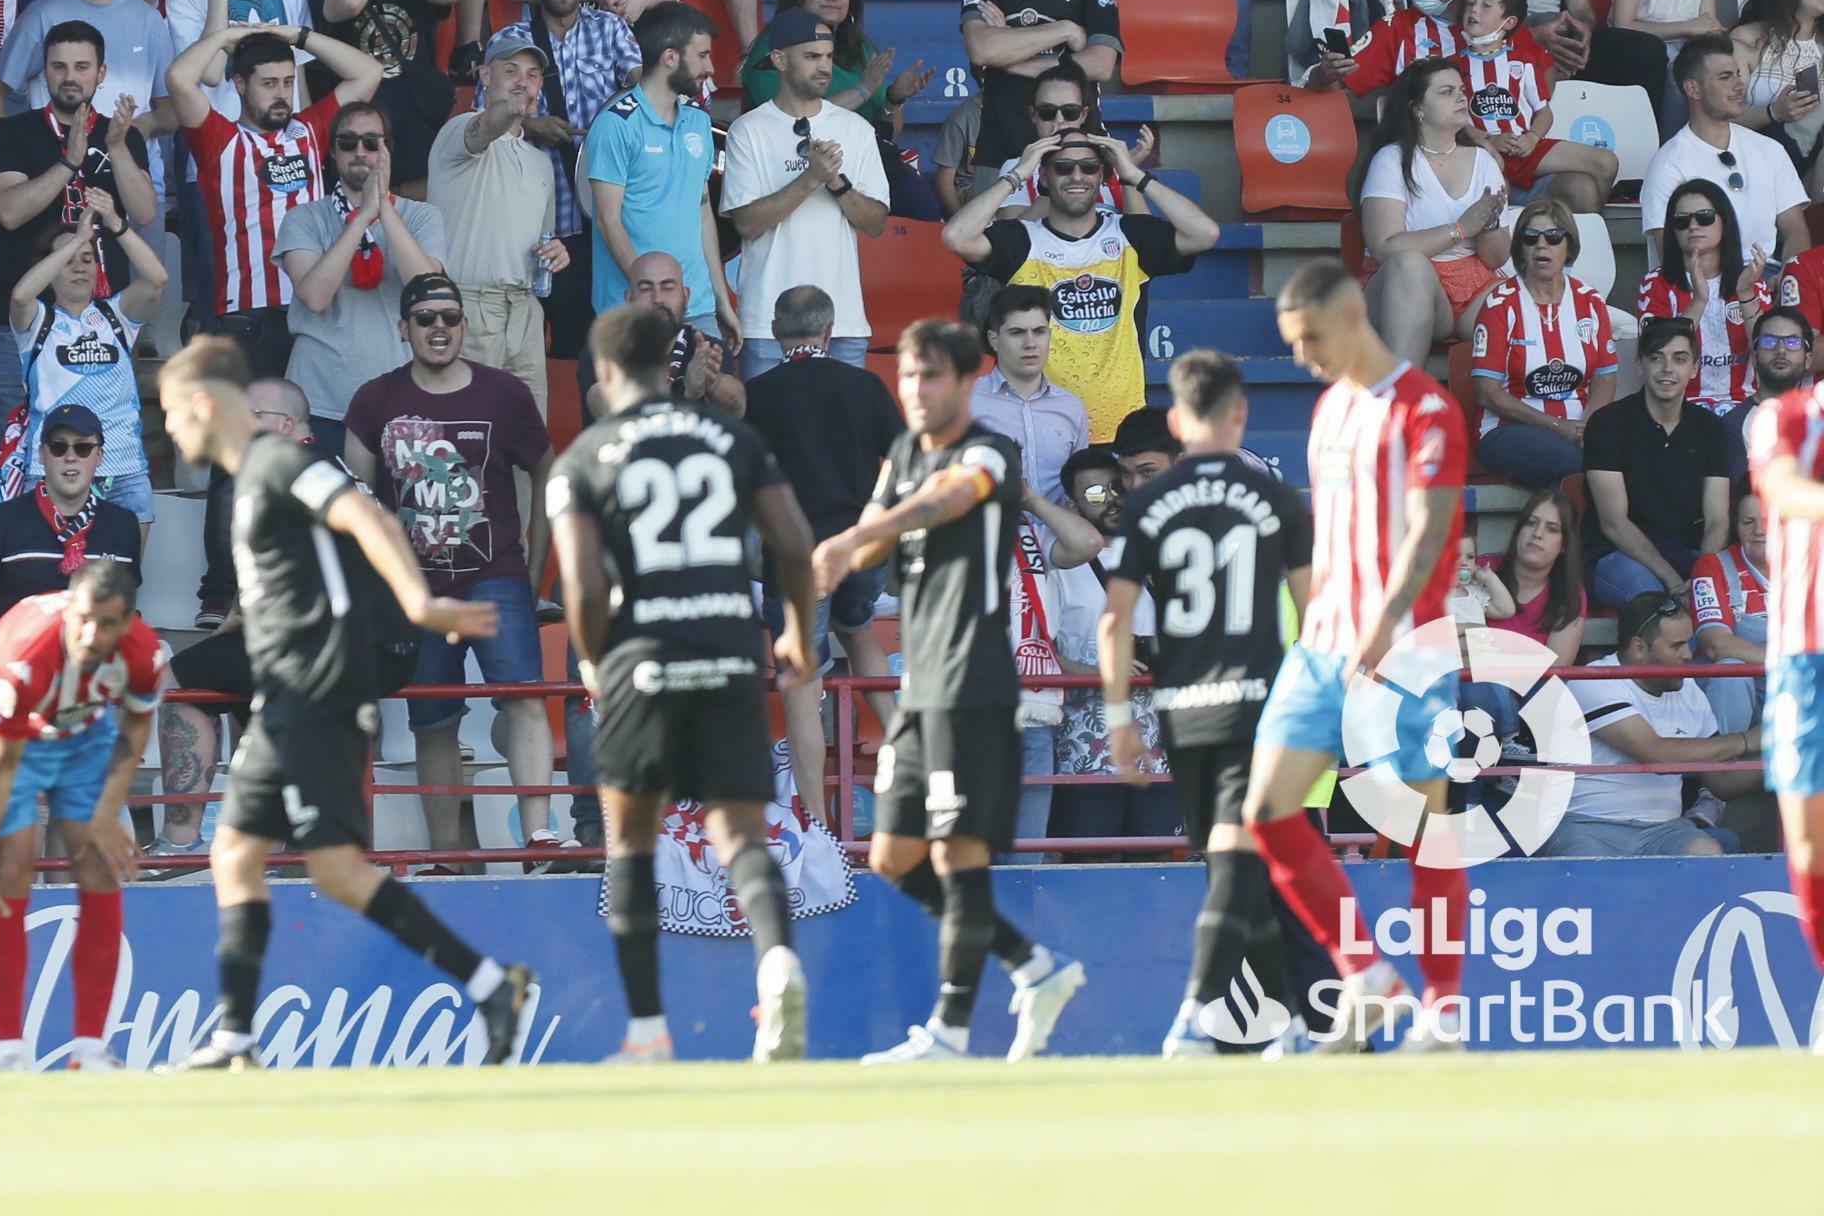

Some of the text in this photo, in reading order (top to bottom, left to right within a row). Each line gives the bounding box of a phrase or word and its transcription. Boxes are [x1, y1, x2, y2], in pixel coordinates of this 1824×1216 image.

[944, 67, 968, 97] 8
[1277, 94, 1291, 105] 34
[267, 159, 306, 176] Estrella
[268, 170, 307, 186] Galicia
[1056, 287, 1118, 306] Estrella
[1060, 302, 1117, 322] Galicia
[1149, 325, 1174, 359] 6
[68, 348, 111, 364] Galicia
[1531, 373, 1578, 386] Estrella
[1535, 383, 1571, 397] Galicia
[395, 439, 457, 468] NO
[414, 475, 479, 509] MO
[617, 452, 742, 575] 22
[413, 515, 462, 546] RE
[1160, 524, 1257, 637] 31
[1696, 596, 1714, 609] LFP
